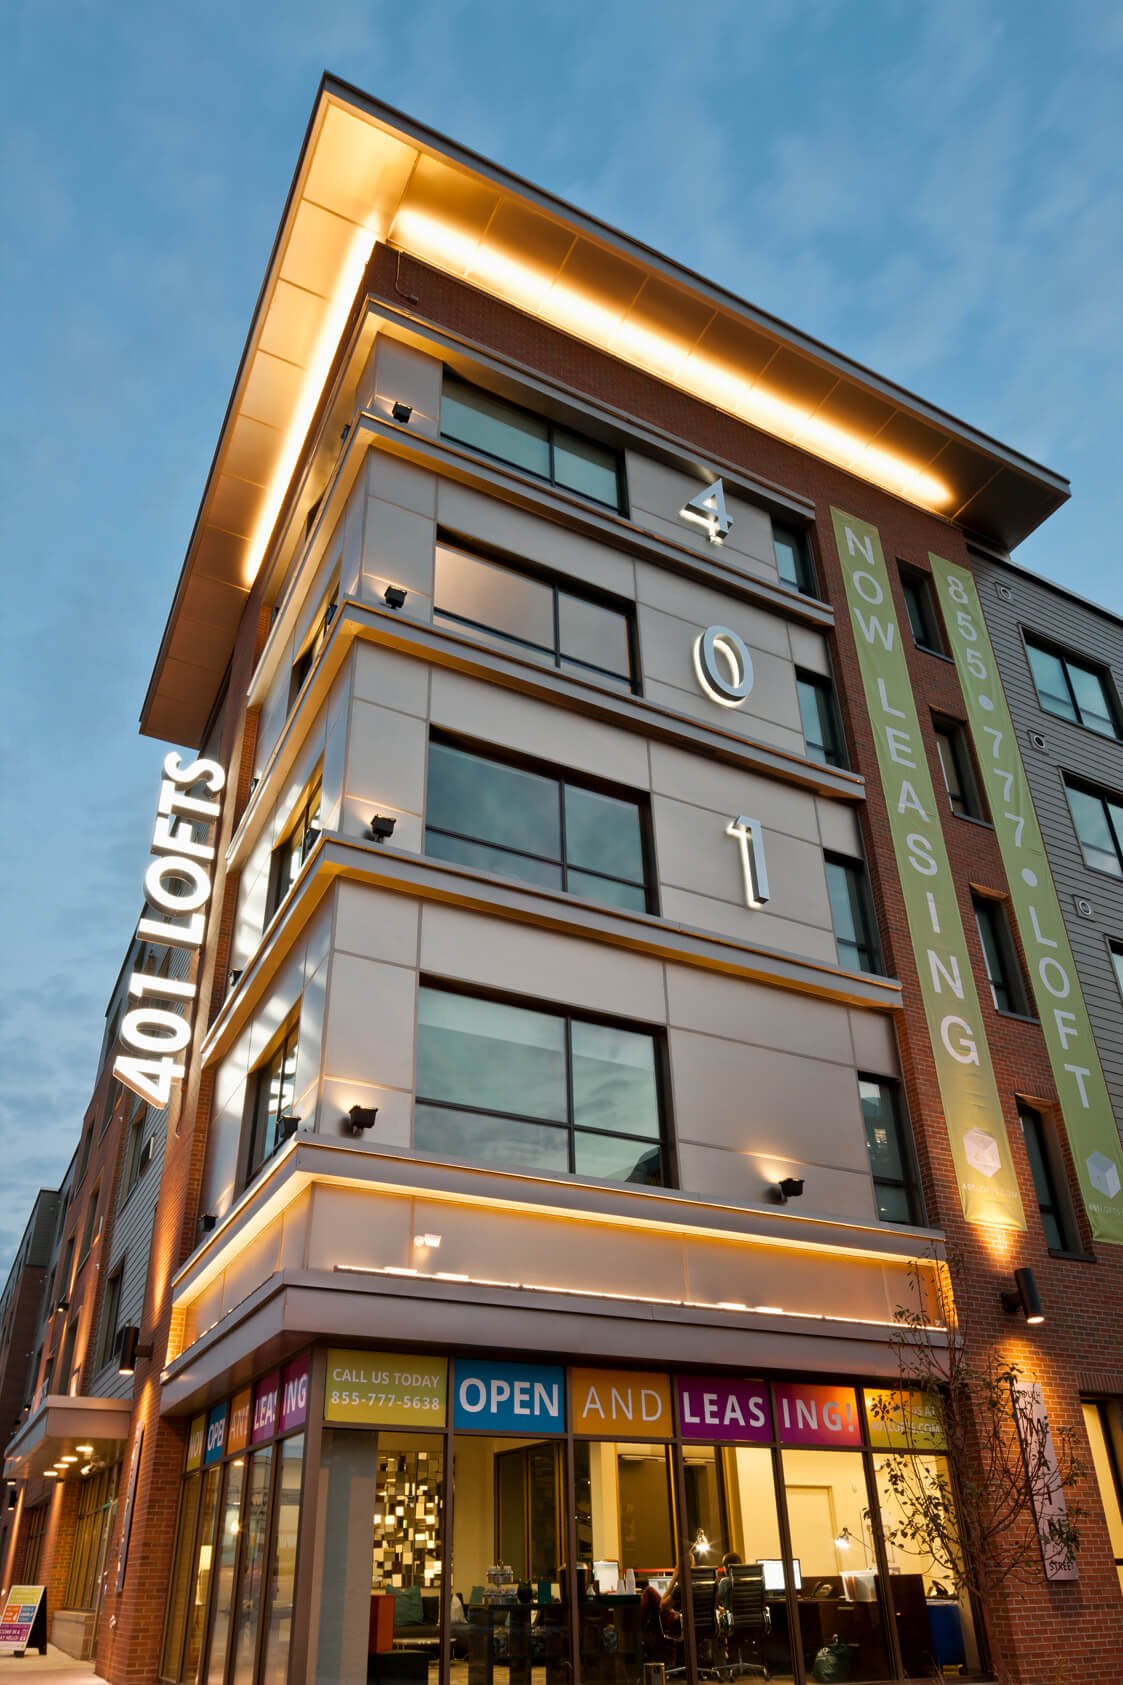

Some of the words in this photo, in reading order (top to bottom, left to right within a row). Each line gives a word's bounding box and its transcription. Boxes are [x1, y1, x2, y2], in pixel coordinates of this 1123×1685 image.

[844, 526, 894, 652] NOW
[877, 677, 980, 1066] LEASING
[135, 751, 226, 946] LOFTS
[112, 971, 198, 1110] 401
[330, 1390, 440, 1411] 855-777-5638
[332, 1367, 368, 1384] CALL
[371, 1369, 390, 1385] US
[393, 1372, 440, 1389] TODAY
[458, 1377, 560, 1417] OPEN
[581, 1385, 664, 1422] AND
